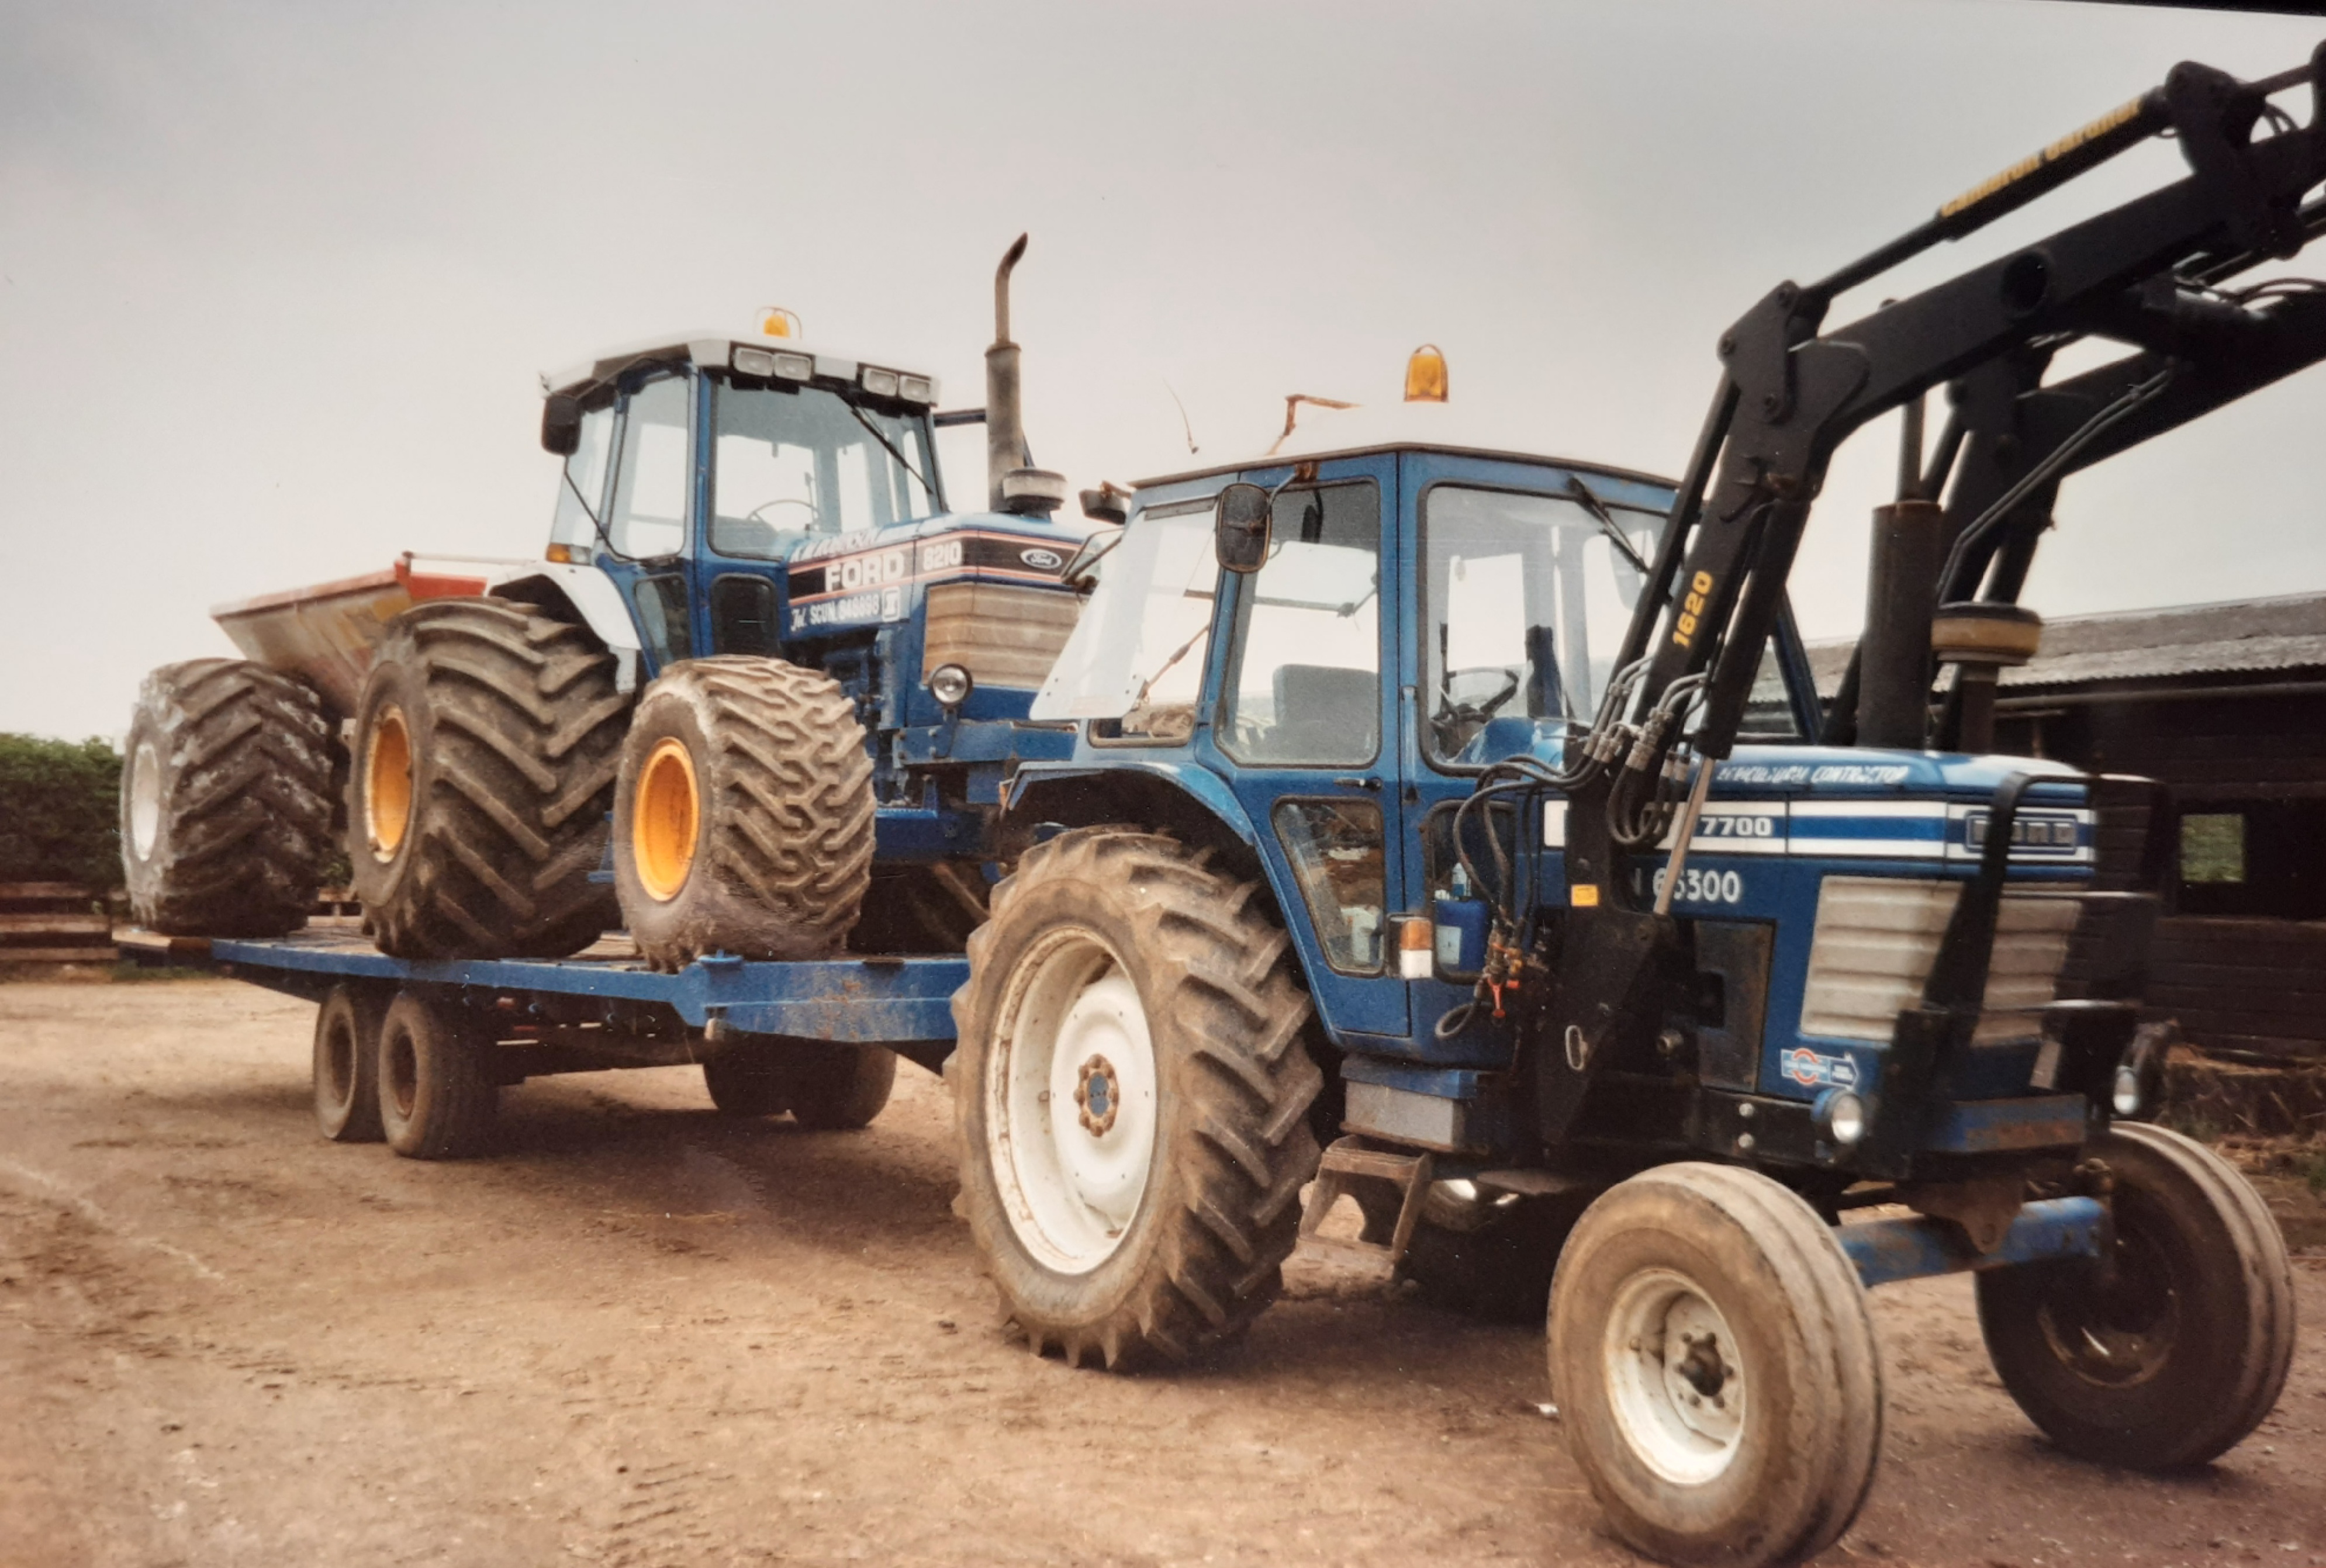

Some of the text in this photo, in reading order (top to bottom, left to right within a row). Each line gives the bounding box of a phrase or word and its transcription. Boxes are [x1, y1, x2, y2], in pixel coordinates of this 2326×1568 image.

[825, 551, 904, 593] FORD
[922, 541, 962, 571] 8210
[1672, 570, 1712, 648] 1620
[1700, 816, 1772, 836] 7700
